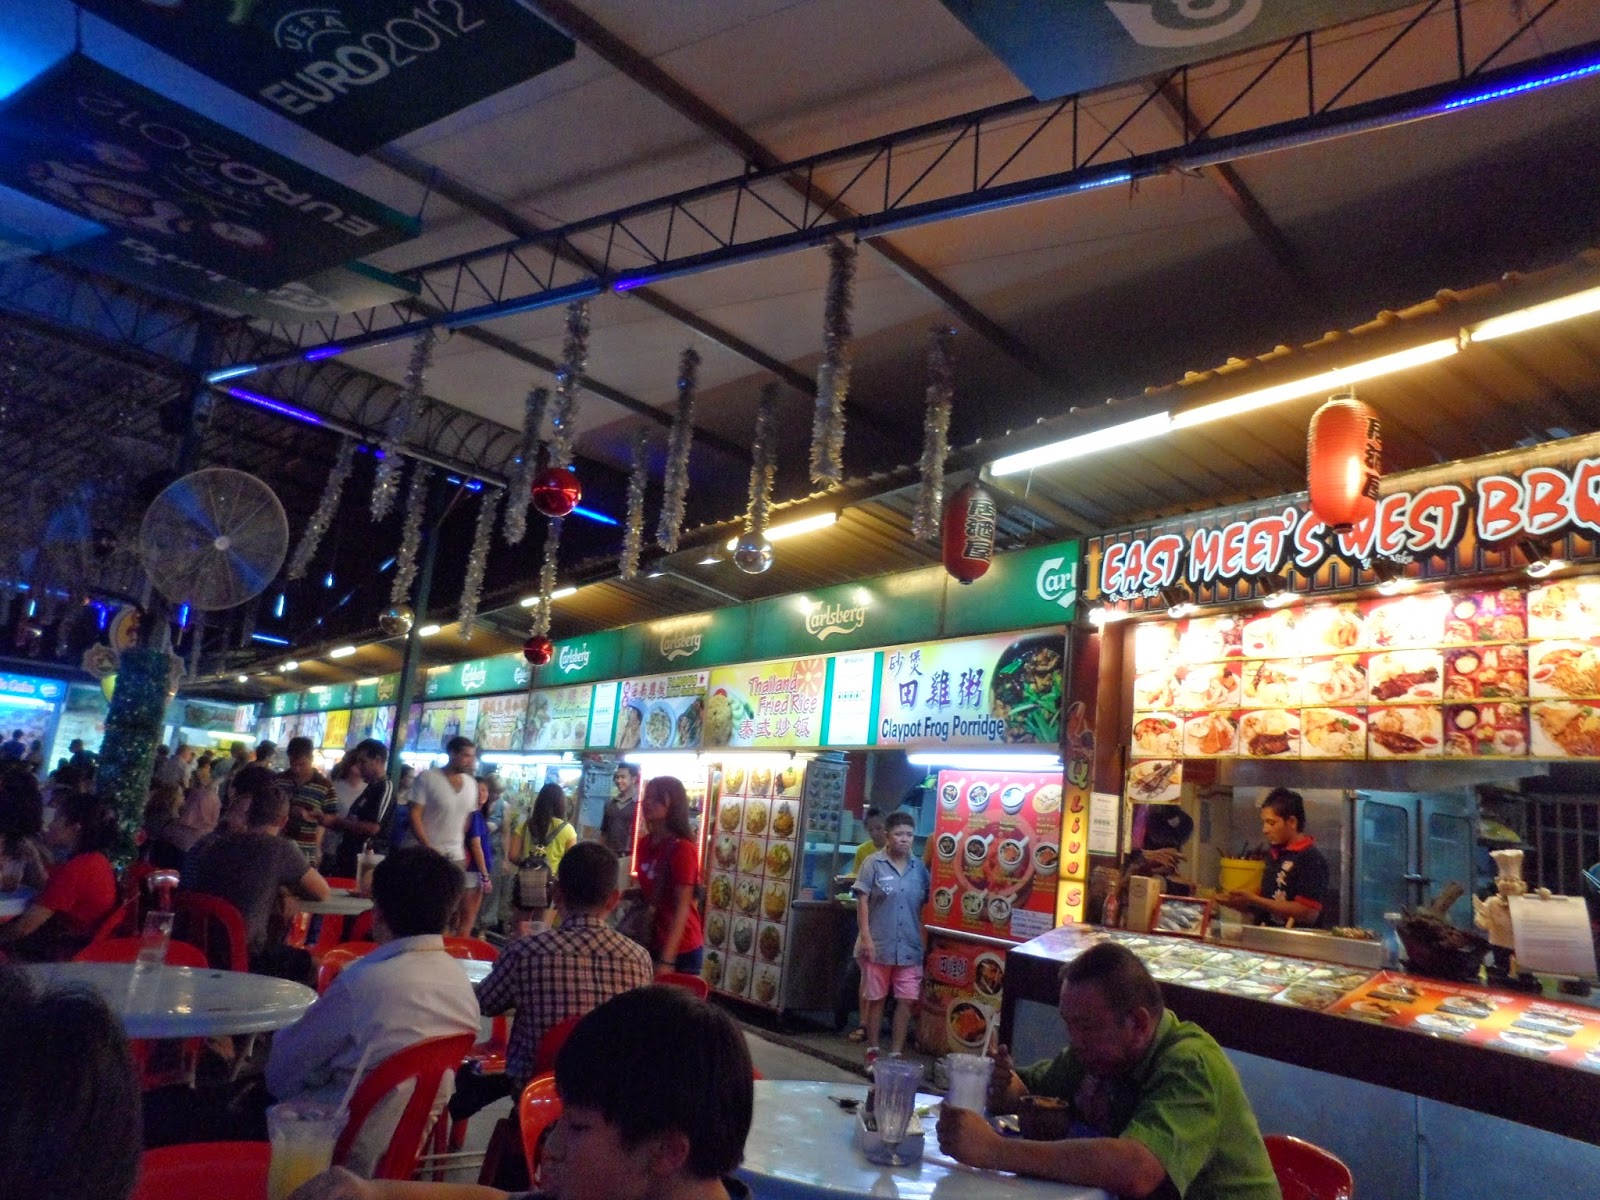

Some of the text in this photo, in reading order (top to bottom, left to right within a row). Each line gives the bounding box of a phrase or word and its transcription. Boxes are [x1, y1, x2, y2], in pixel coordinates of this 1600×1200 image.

[260, 0, 485, 115] EURO2012
[1101, 534, 1184, 594] EAST
[1189, 506, 1326, 582] MEET'S
[1337, 484, 1466, 560] WEST
[1036, 557, 1077, 604] Carl
[805, 600, 867, 638] Carlsberg
[559, 643, 591, 671] Carlsberg
[660, 631, 703, 659] Carlsberg
[749, 670, 799, 696] Thailand
[757, 695, 790, 716] Fried
[790, 693, 818, 714] Rice
[881, 713, 1004, 743] Claypot Frog Porridge
